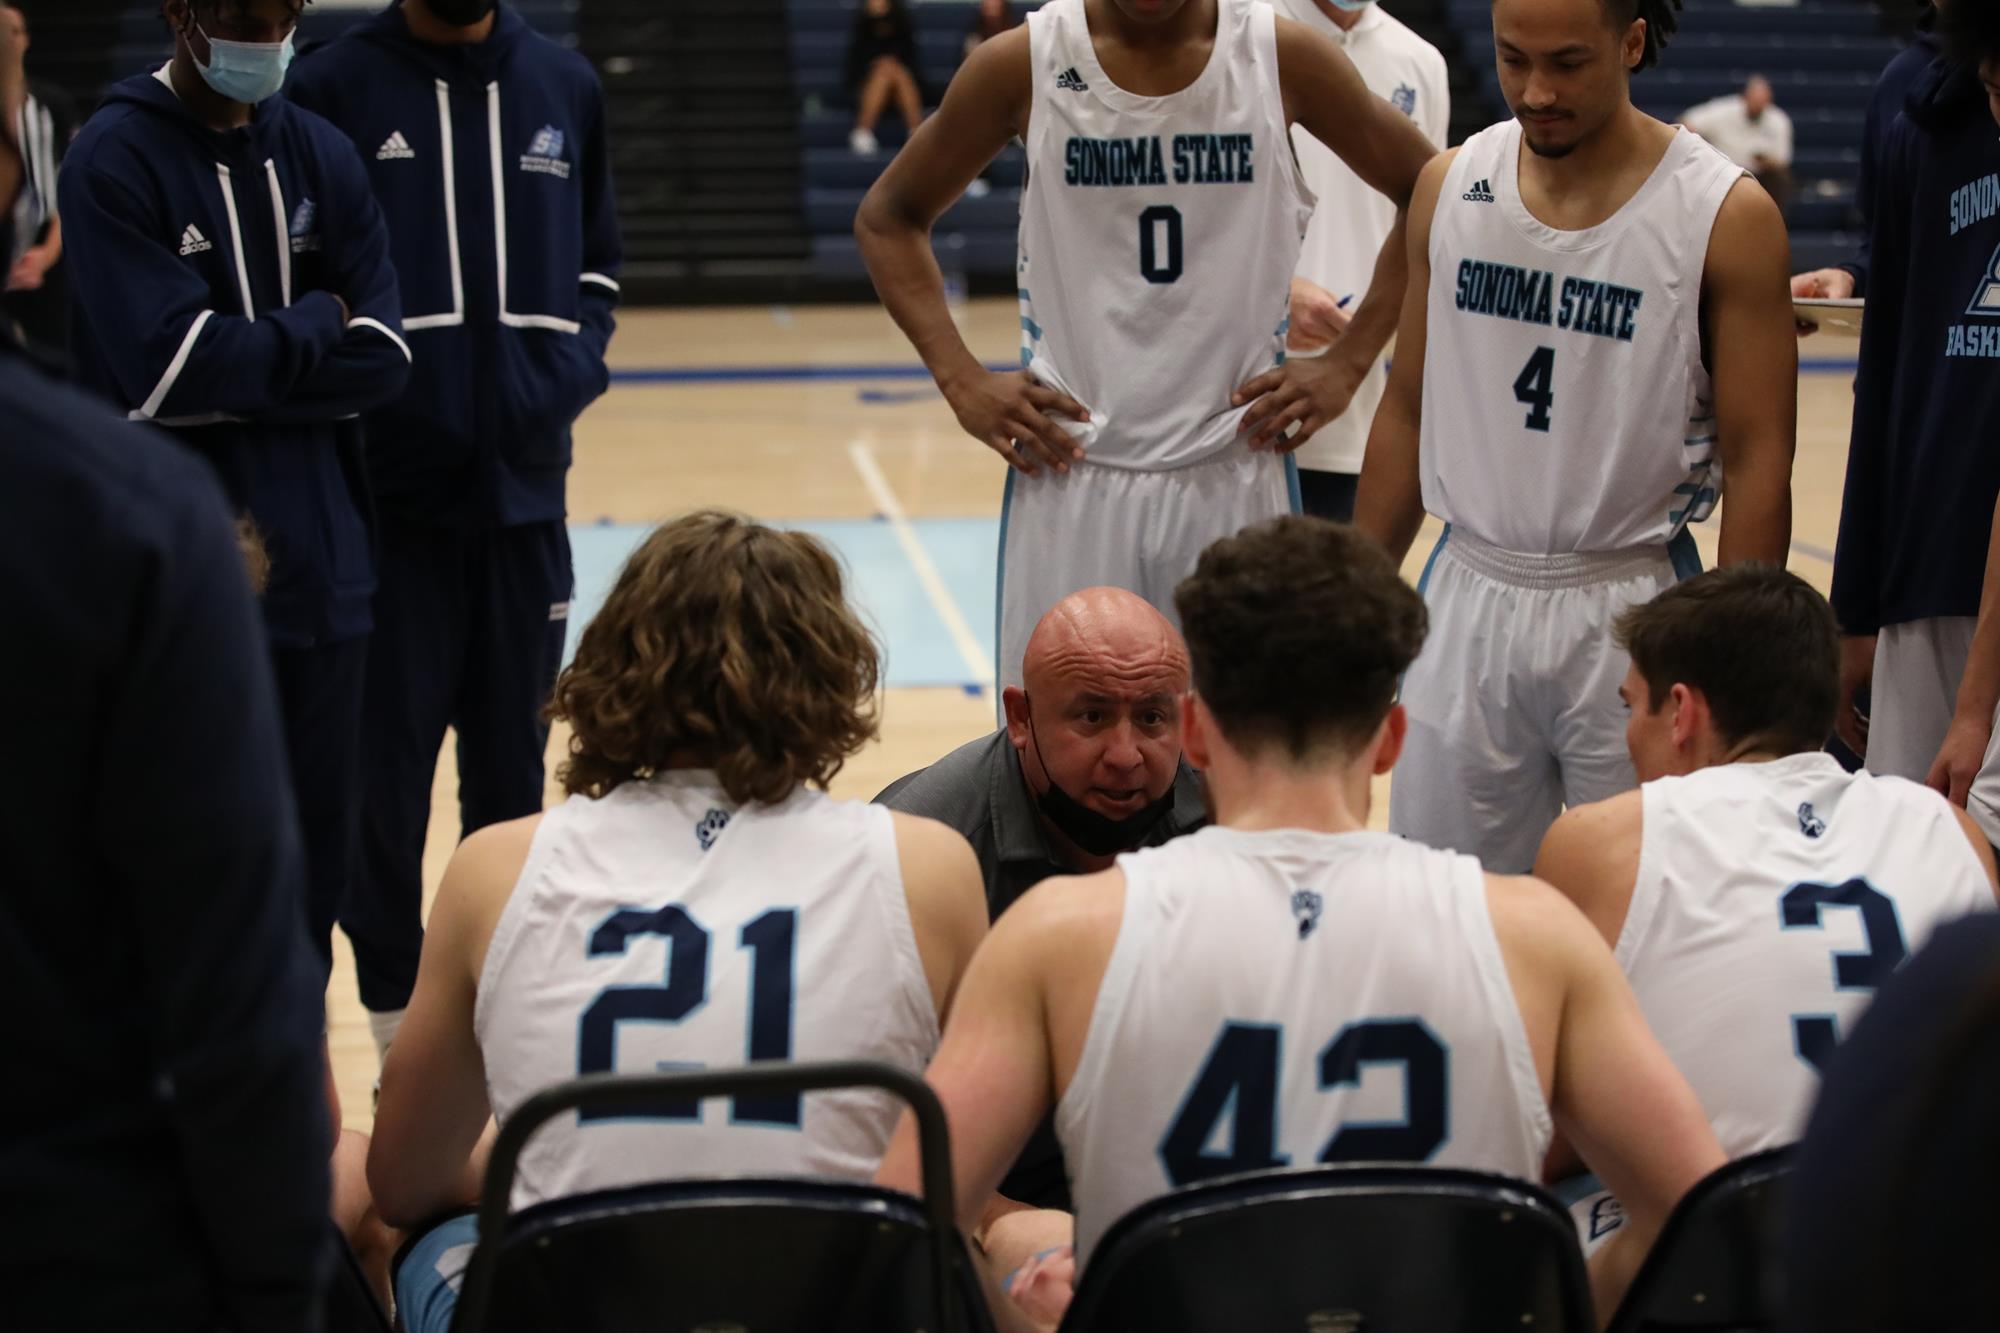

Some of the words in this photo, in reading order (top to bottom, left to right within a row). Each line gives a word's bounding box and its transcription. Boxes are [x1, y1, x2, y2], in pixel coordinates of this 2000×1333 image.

[1064, 136, 1168, 187] SONOMA
[1172, 133, 1254, 185] STATE
[1462, 191, 1495, 203] adidas
[179, 240, 212, 256] adidas
[1138, 205, 1184, 285] 0
[1455, 257, 1555, 327] SONOMA
[1557, 275, 1644, 343] STATE
[1945, 324, 2000, 358] BASK
[1513, 345, 1556, 433] 4
[576, 902, 804, 1131] 21
[1777, 875, 1912, 1079] 3
[1156, 1015, 1450, 1188] 42
